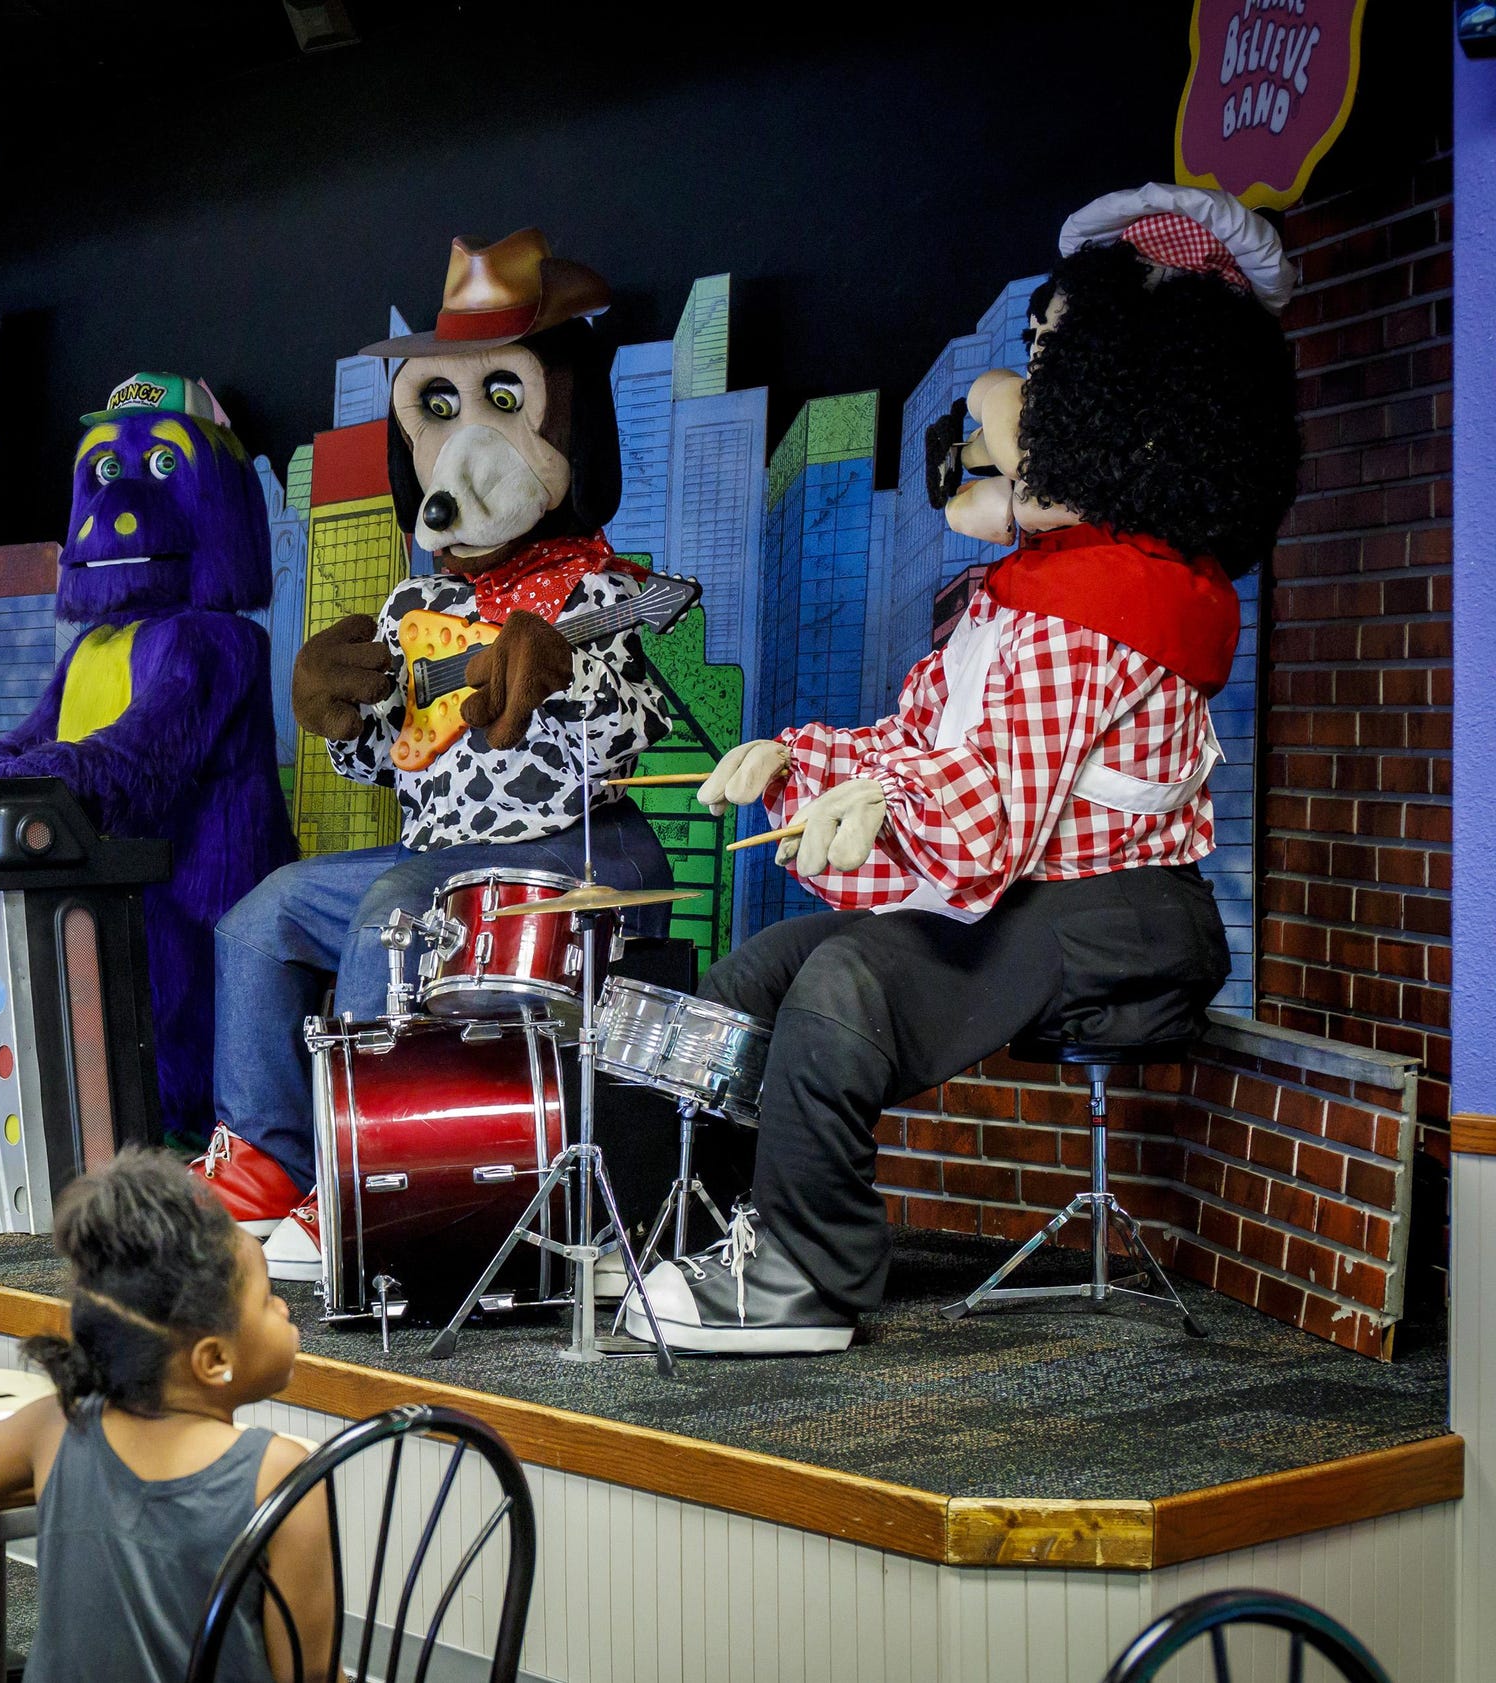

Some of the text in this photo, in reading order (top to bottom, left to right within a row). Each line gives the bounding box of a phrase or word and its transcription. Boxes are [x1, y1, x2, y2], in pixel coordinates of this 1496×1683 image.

[1220, 15, 1321, 95] BELIEVE
[1222, 80, 1291, 139] BAND
[109, 383, 164, 409] MUNCH
